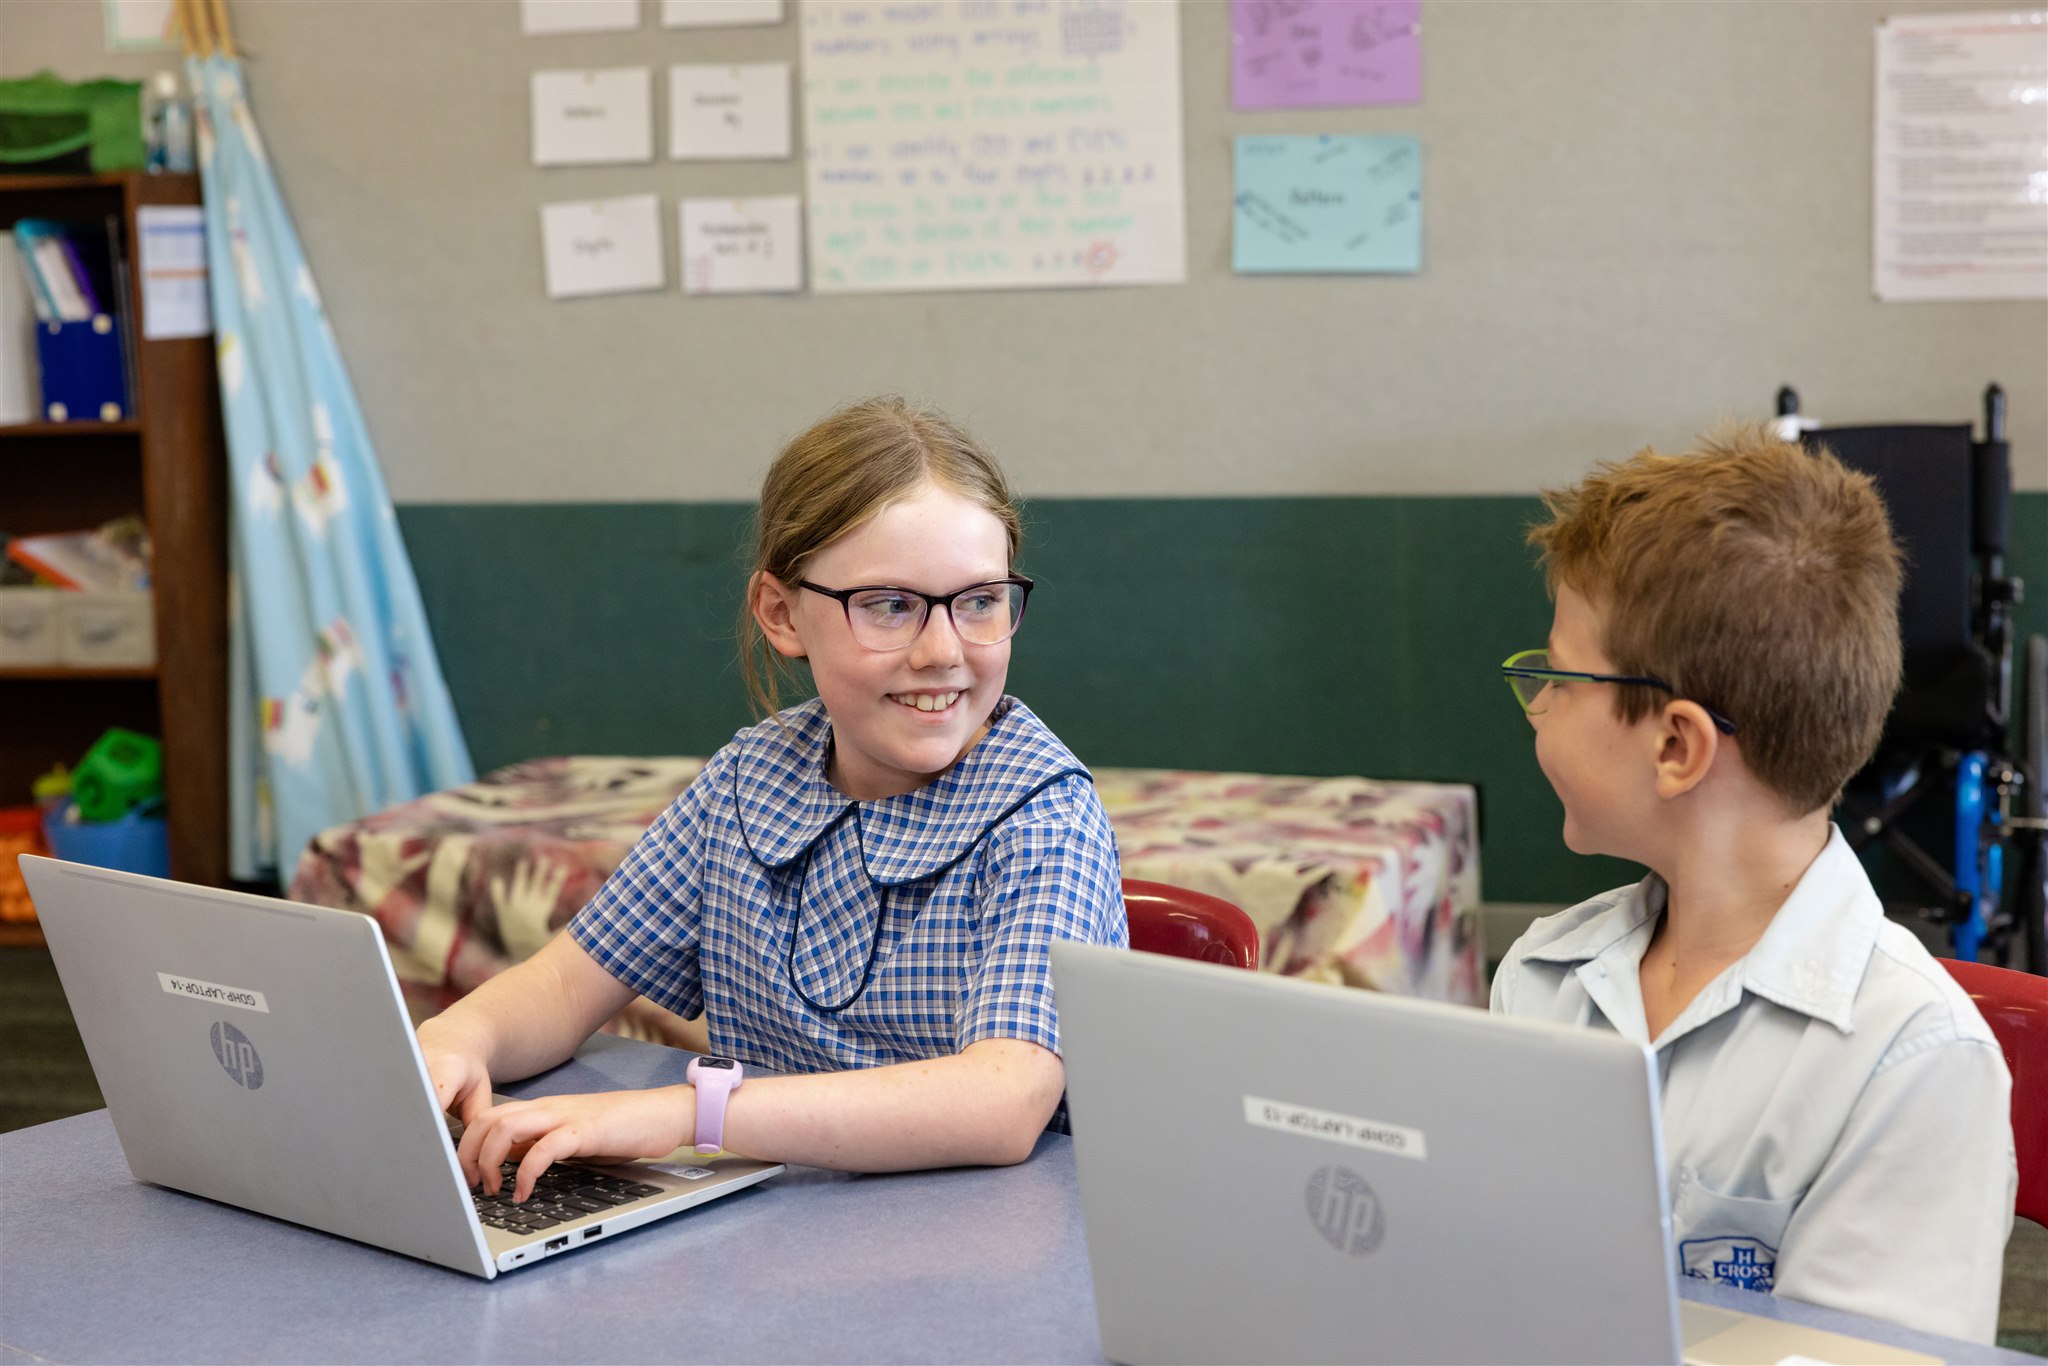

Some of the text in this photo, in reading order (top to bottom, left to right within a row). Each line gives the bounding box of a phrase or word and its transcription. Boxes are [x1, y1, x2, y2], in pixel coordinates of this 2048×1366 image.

[171, 979, 256, 1006] GDHP-LAPTOP-14
[217, 1021, 257, 1090] hp
[1316, 1166, 1377, 1257] hp
[1717, 1263, 1771, 1278] CROSS
[1738, 1250, 1752, 1265] H
